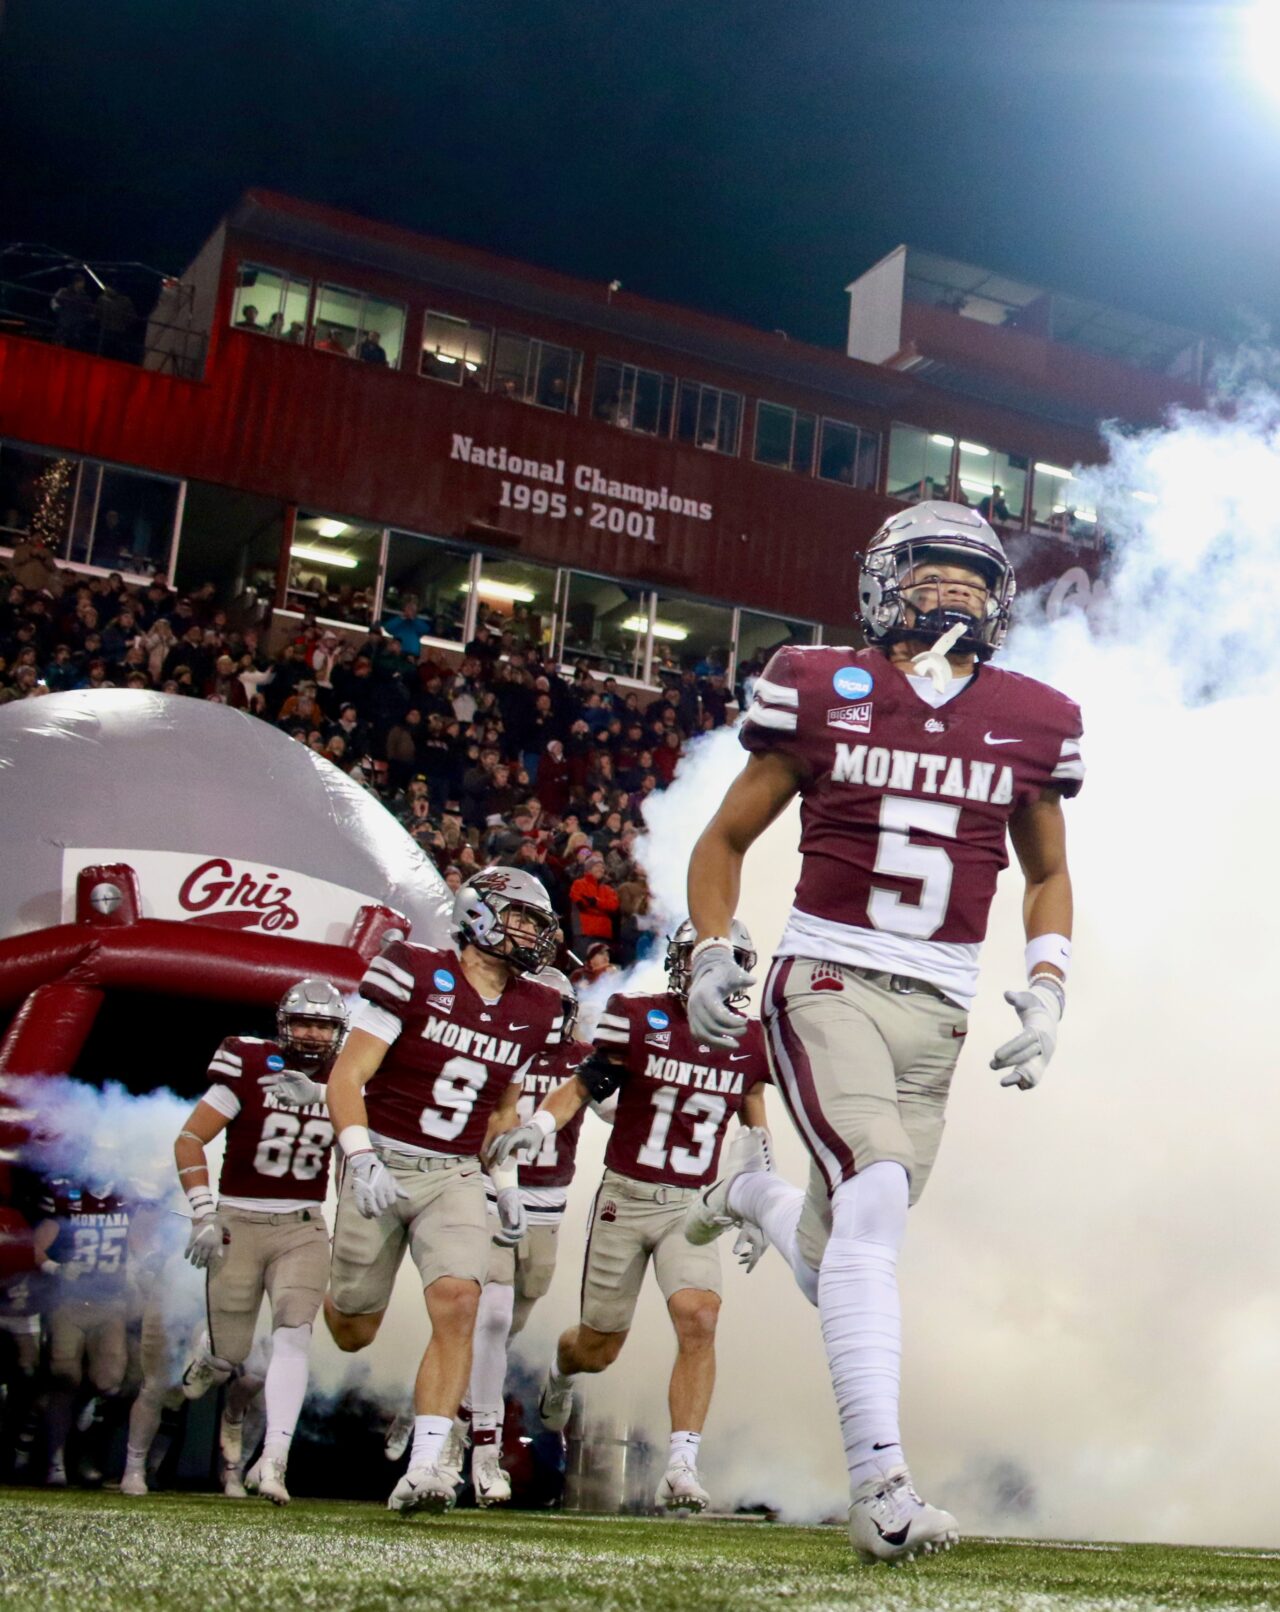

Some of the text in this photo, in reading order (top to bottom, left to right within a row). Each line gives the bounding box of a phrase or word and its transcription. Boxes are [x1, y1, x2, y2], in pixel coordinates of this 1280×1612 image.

[451, 433, 713, 520] National Champions
[499, 481, 656, 541] 1995 2001
[830, 742, 1014, 805] MONTANA
[178, 858, 300, 931] Griz
[866, 794, 963, 940] 5
[420, 1015, 522, 1067] MONTANA
[644, 1053, 745, 1095] MONTANA
[419, 1055, 489, 1142] 9
[636, 1085, 728, 1176] 13
[253, 1111, 335, 1181] 88
[70, 1213, 130, 1226] MONTANA
